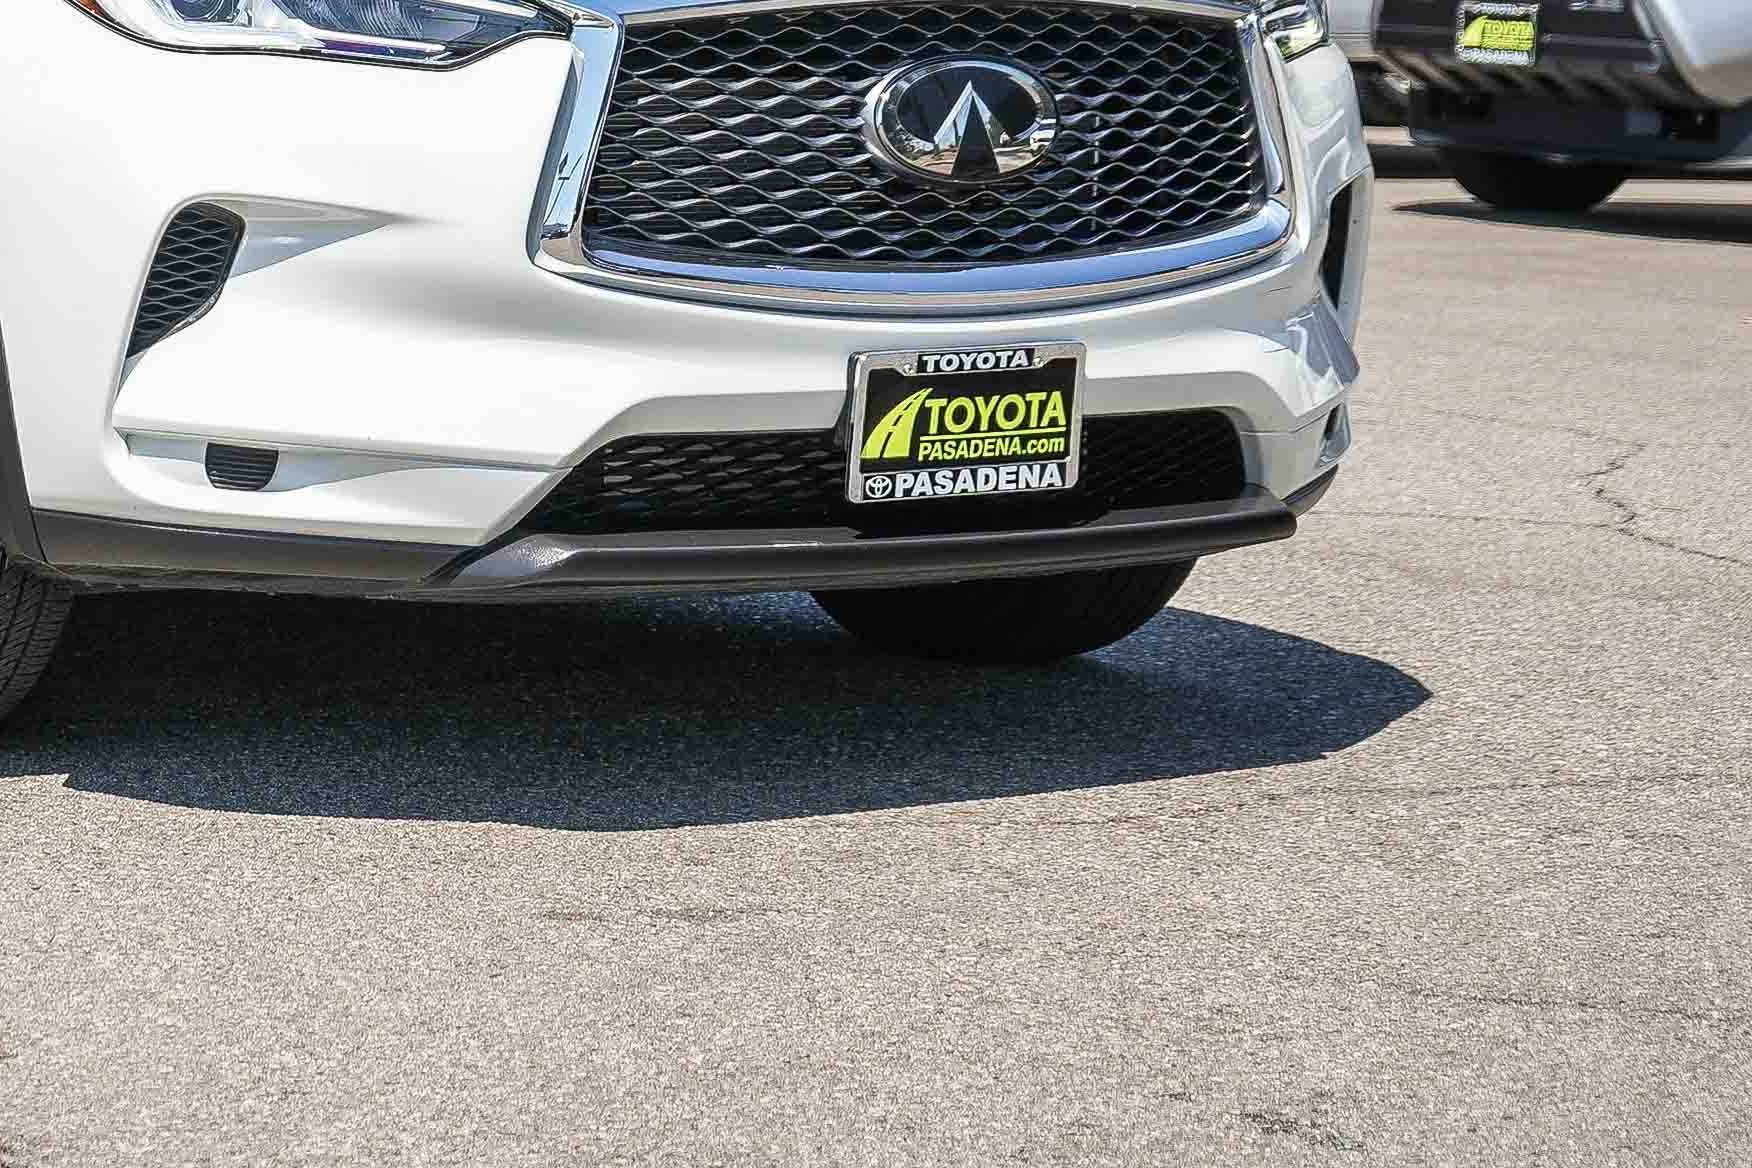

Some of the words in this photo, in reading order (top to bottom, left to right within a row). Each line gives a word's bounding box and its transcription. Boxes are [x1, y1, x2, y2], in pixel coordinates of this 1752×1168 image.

[922, 349, 1030, 373] TOYOTA
[924, 390, 1067, 434] TOYOTA
[917, 436, 1066, 462] PASADENA.com
[894, 463, 1063, 497] PASADENA
